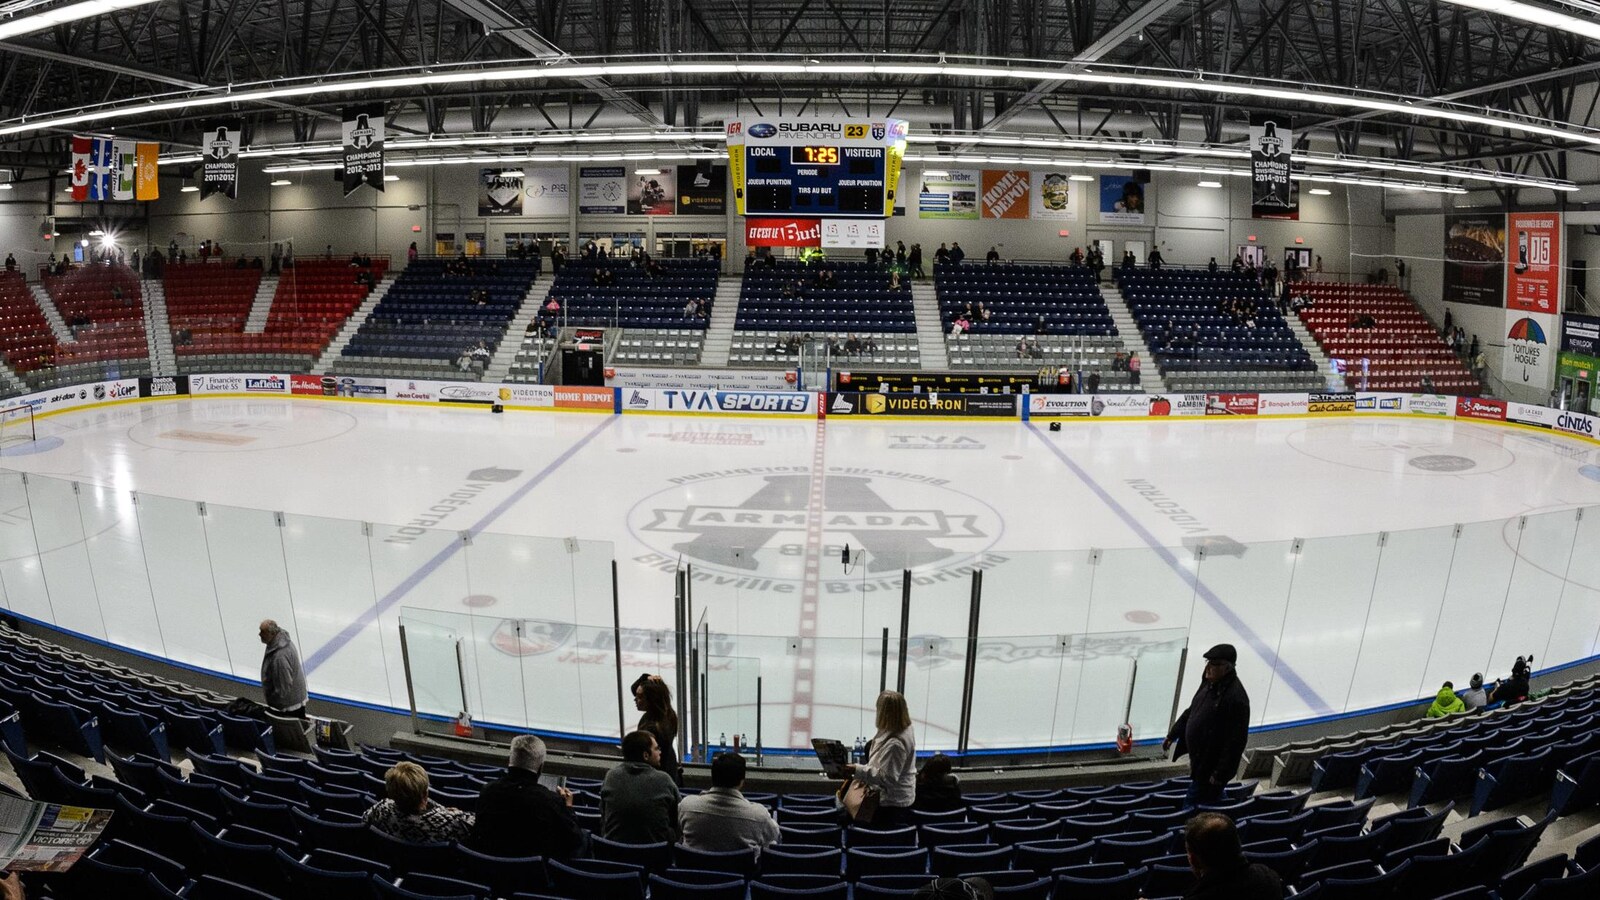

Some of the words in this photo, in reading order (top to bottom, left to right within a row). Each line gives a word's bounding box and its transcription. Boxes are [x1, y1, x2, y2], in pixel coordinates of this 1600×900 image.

[727, 122, 742, 135] IGA
[779, 123, 841, 132] SUBARU
[847, 126, 863, 137] 23
[873, 128, 884, 137] 15
[779, 132, 841, 140] RIVE-NORD
[346, 151, 381, 162] CHAMPIONS
[750, 147, 776, 157] LOCAL
[804, 147, 837, 163] 7:25
[845, 148, 882, 158] VISITEUR
[346, 164, 381, 174] 2012-2013
[1254, 161, 1288, 170] CHAMIONS
[982, 170, 1020, 208] HOME
[990, 177, 1030, 219] DEPOT
[749, 227, 757, 238] ET
[772, 228, 779, 239] LE
[1512, 343, 1540, 357] TOITURES
[1514, 354, 1537, 366] HOGUE
[1561, 356, 1572, 366] Bon
[209, 376, 242, 384] Financière
[247, 380, 283, 389] Lafleur
[291, 381, 301, 389] Tim
[301, 381, 322, 390] Hortons
[206, 383, 229, 391] Liberté
[555, 392, 581, 402] HOME
[583, 393, 613, 403] DEPOT
[663, 391, 713, 410] TVA
[722, 393, 807, 412] SPORTS
[1308, 402, 1325, 412] Cub
[1326, 403, 1354, 412] Cadet
[888, 435, 980, 443] TVA
[667, 466, 809, 485] Boisbriand
[828, 466, 951, 486] Blainville
[697, 511, 930, 526] ARMADA
[632, 552, 796, 594] Blainville
[825, 552, 1011, 595] Boisbriand
[32, 835, 76, 846] VICTOIRE
